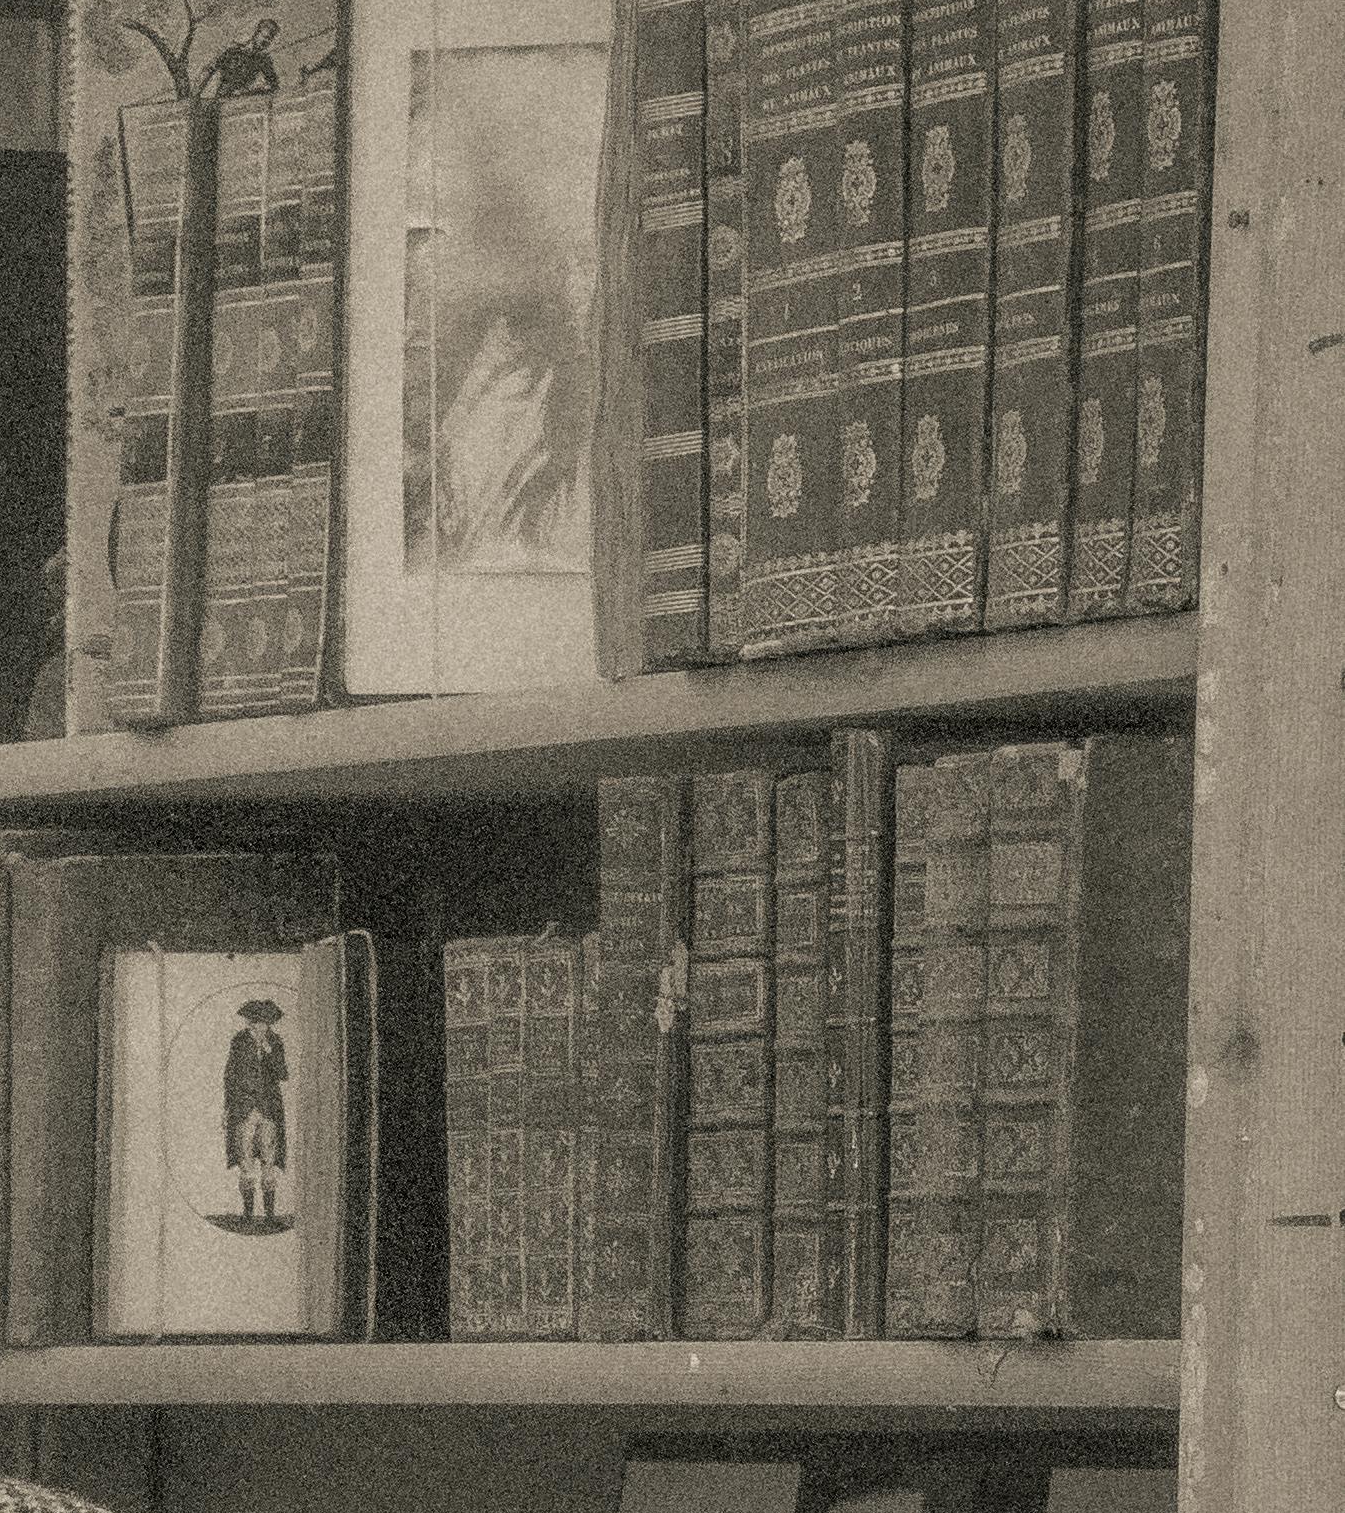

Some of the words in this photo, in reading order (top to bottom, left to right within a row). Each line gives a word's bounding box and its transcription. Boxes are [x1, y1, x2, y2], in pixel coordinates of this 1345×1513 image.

[847, 38, 901, 60] PLANTES
[843, 64, 897, 86] ANIMAUX
[782, 84, 832, 107] ANIMAUX
